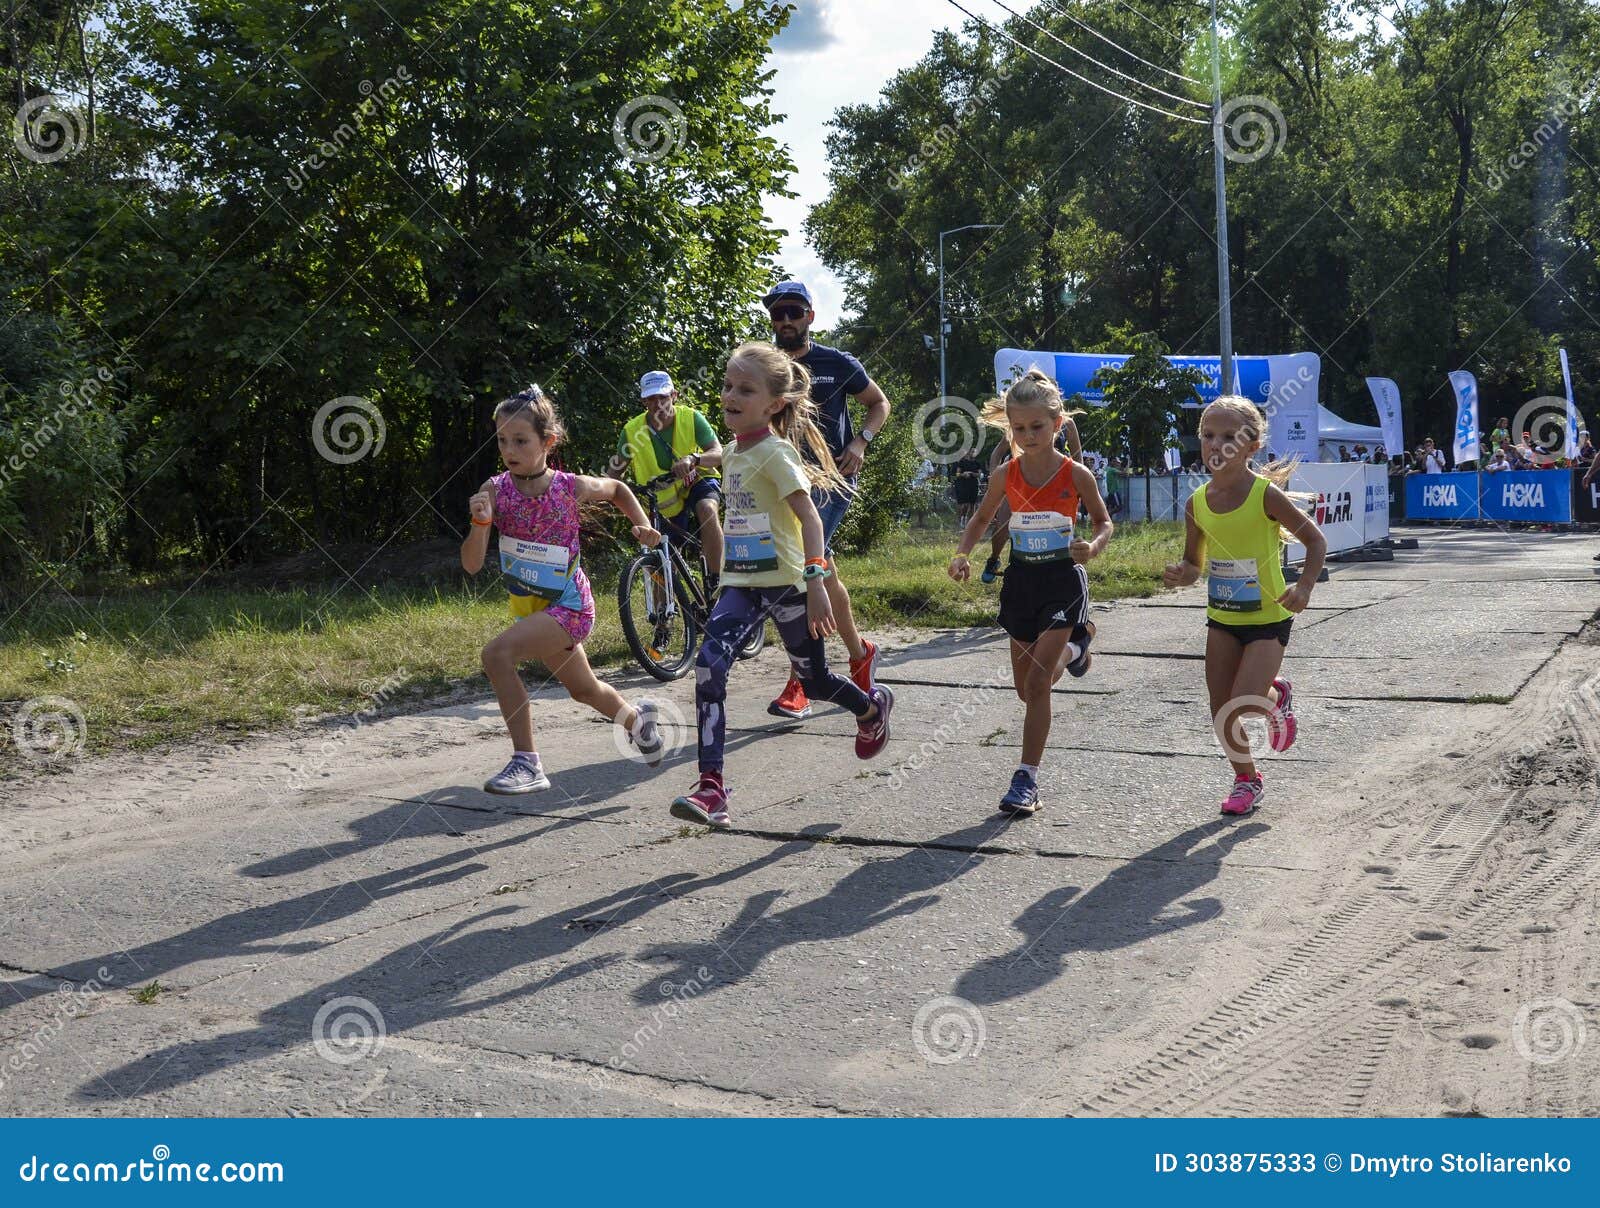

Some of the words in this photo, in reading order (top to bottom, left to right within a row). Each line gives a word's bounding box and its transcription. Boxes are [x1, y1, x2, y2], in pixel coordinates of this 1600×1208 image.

[1423, 484, 1458, 507] HOKA
[1502, 483, 1545, 508] HOKA
[1027, 538, 1048, 550] 503
[520, 567, 538, 583] 509
[1216, 584, 1233, 598] 505
